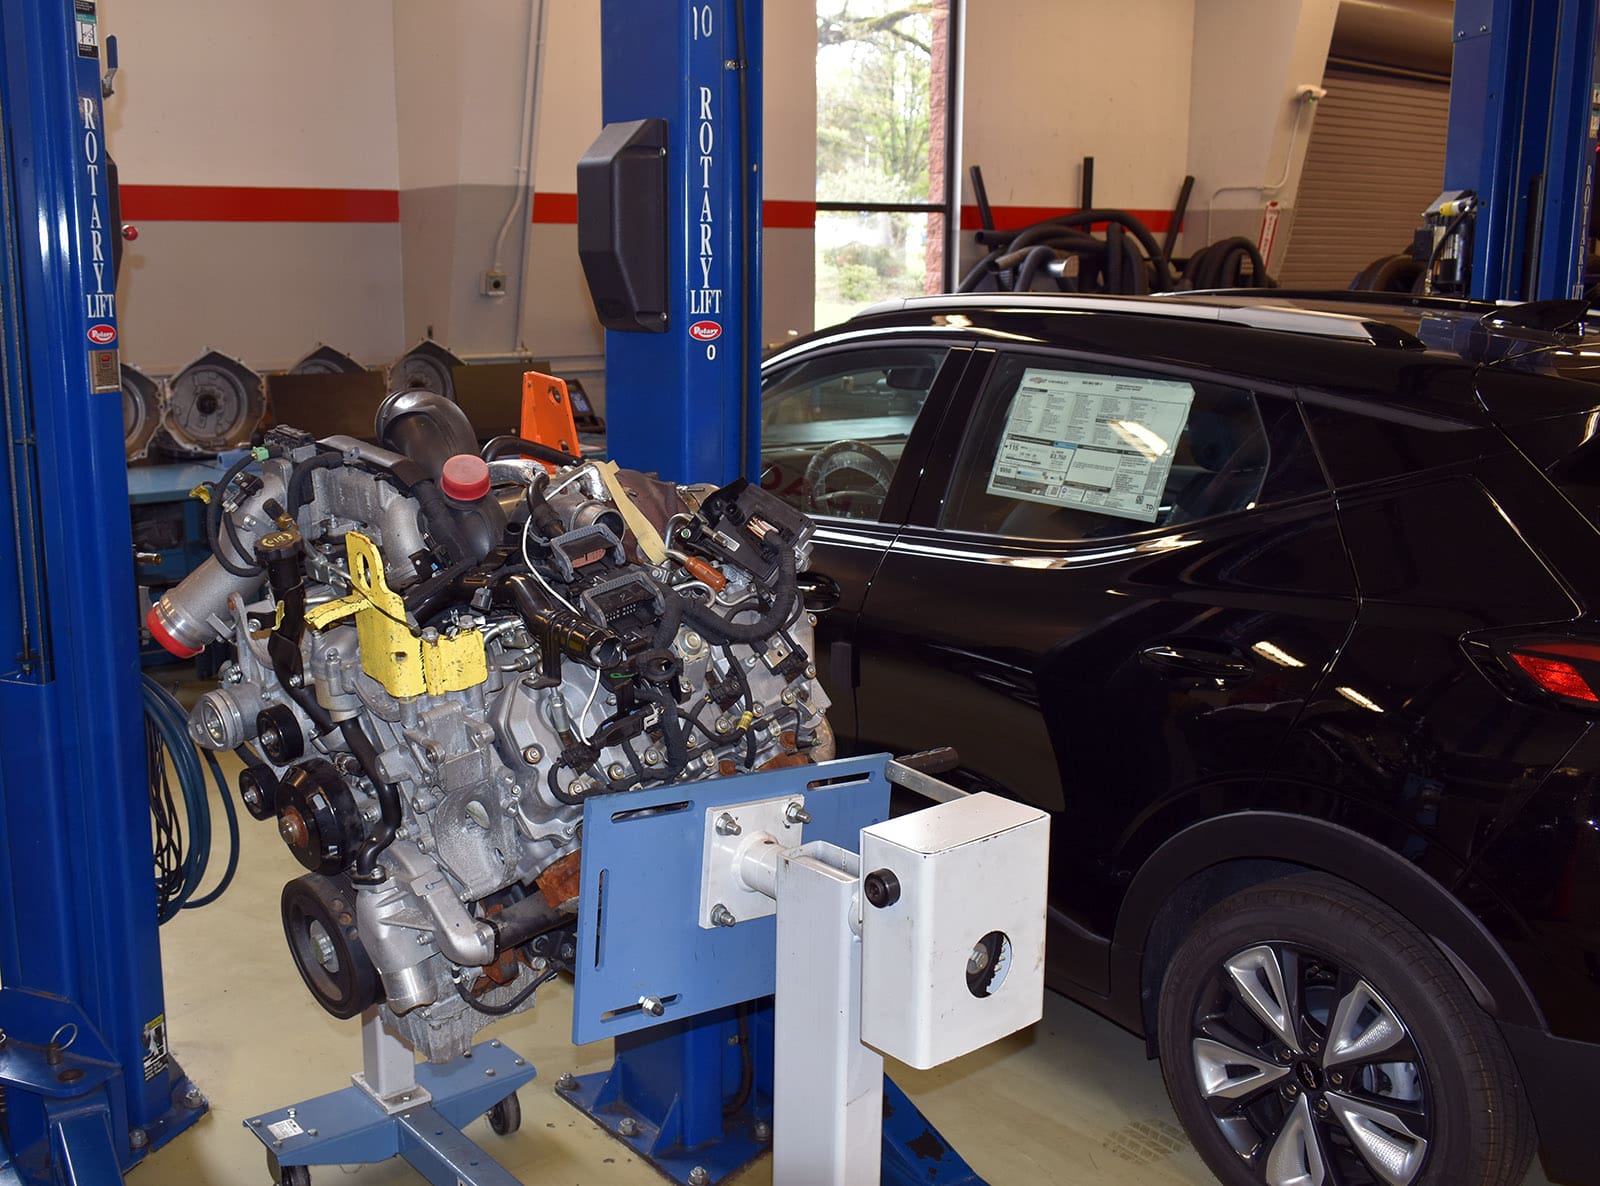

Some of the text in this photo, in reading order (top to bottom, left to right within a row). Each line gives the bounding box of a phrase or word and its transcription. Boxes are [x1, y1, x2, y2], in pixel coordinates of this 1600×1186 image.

[693, 5, 712, 40] 10
[83, 97, 104, 293] ROTARY
[699, 87, 713, 289] ROTARY
[87, 294, 115, 318] LIFT
[690, 289, 722, 314] LIFT
